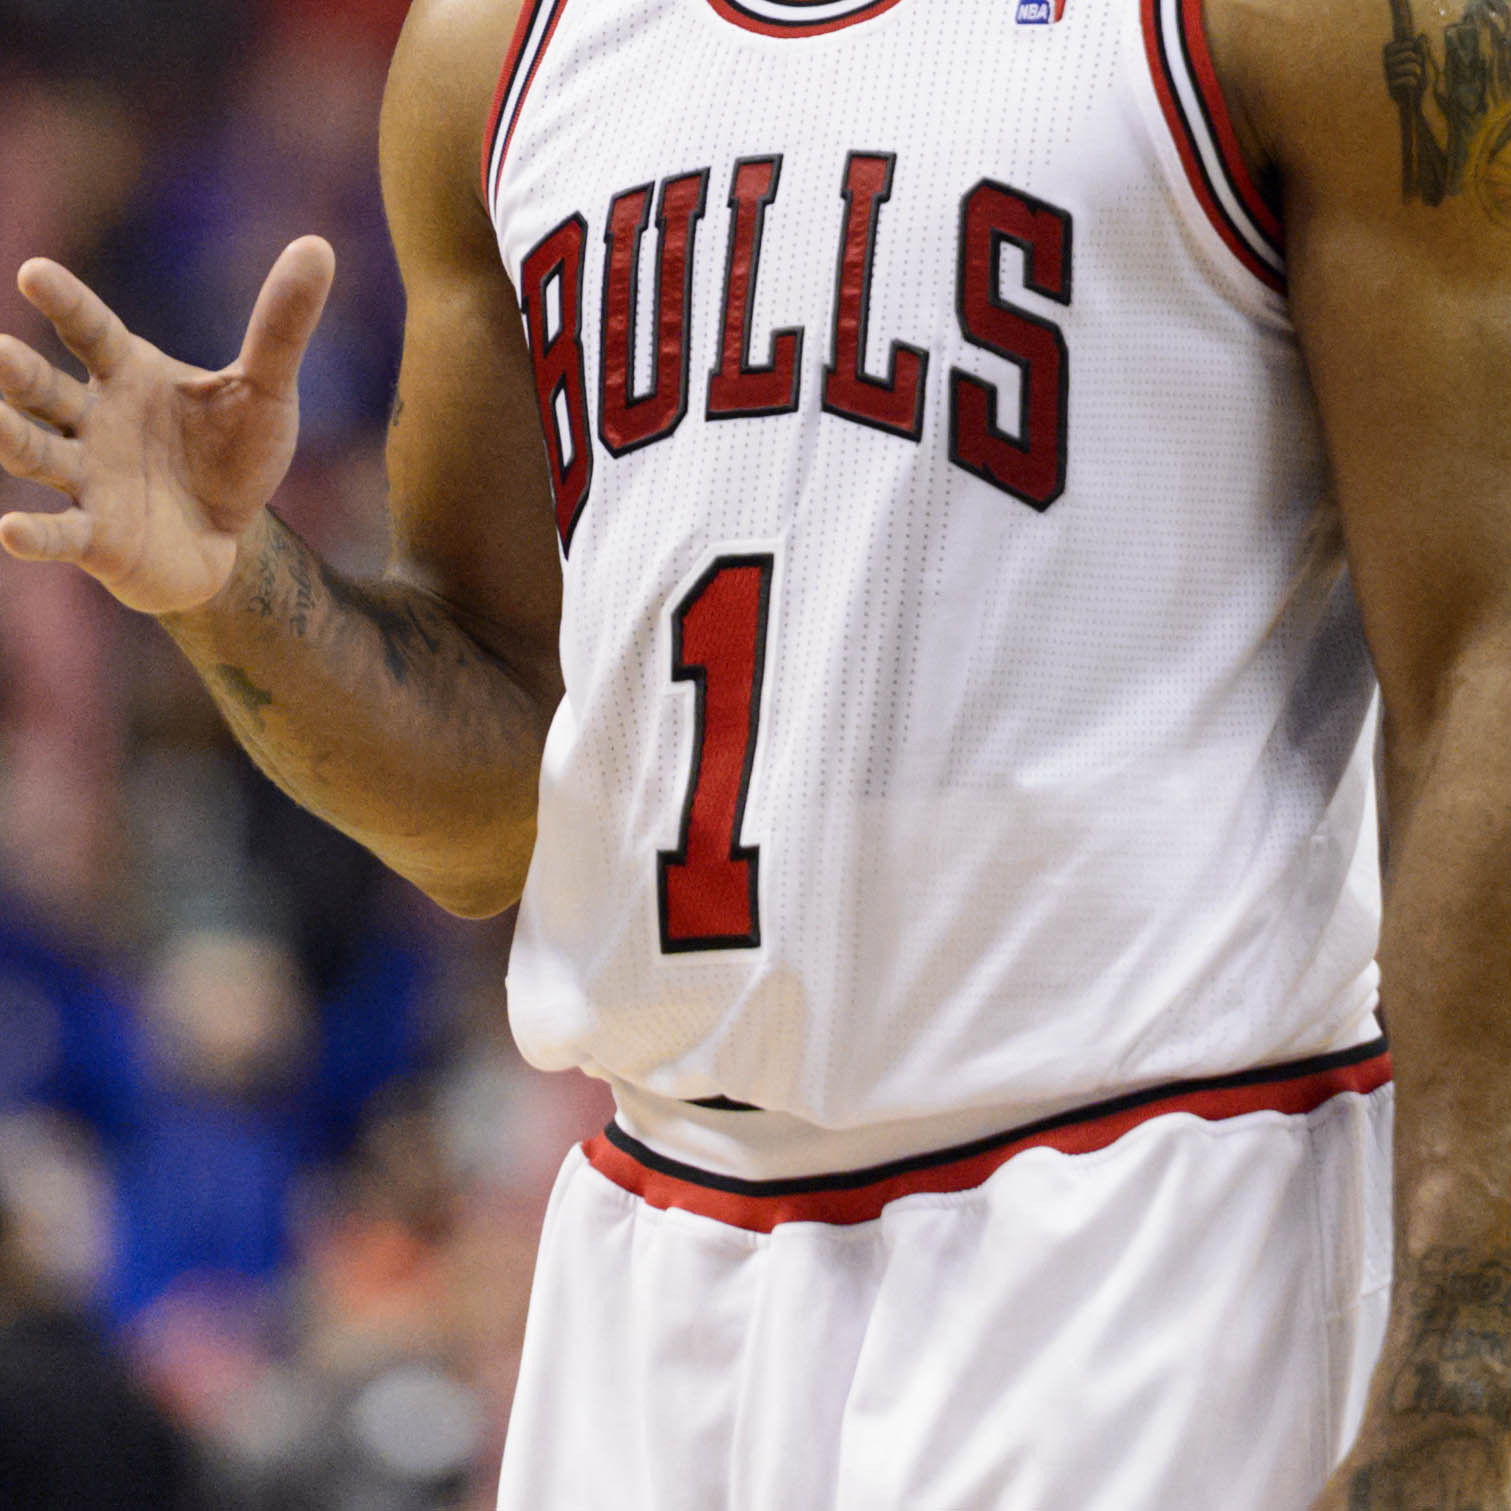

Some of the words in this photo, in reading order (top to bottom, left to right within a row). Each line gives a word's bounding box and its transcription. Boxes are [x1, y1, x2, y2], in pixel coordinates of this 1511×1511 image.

[1017, 2, 1050, 21] NBA
[520, 149, 1074, 561] BULLS
[656, 551, 775, 956] 1
